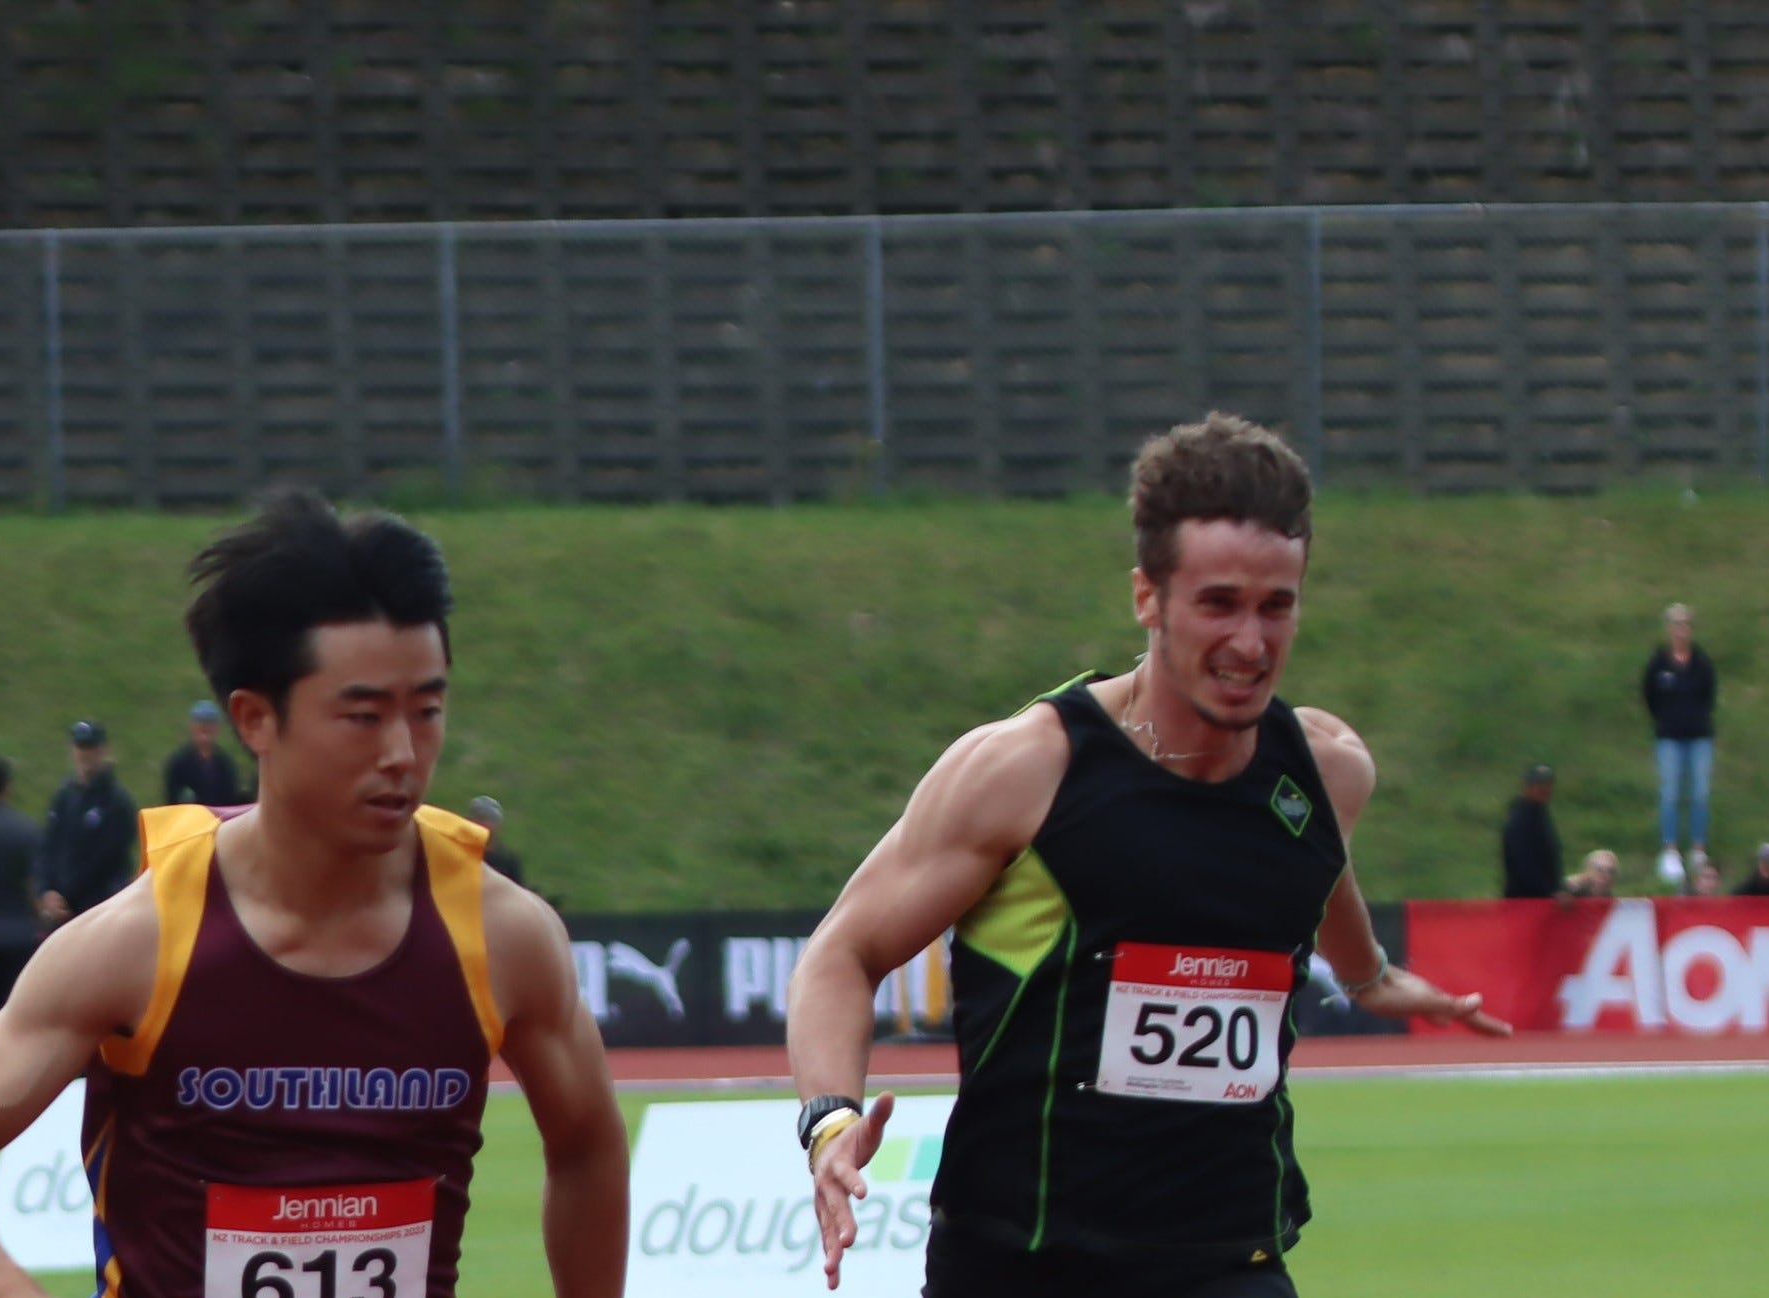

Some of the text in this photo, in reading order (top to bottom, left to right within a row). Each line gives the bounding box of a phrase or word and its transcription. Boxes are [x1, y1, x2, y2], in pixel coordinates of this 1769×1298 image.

[1168, 952, 1249, 978] Jennian
[1131, 1002, 1259, 1070] 520
[178, 1066, 470, 1110] SOUTHLAND
[272, 1194, 378, 1220] Jennian
[231, 1233, 269, 1245] TRACK
[281, 1236, 312, 1245] FIELD
[313, 1230, 402, 1246] CHAMPIONSHIPS
[640, 1181, 930, 1274] dougas
